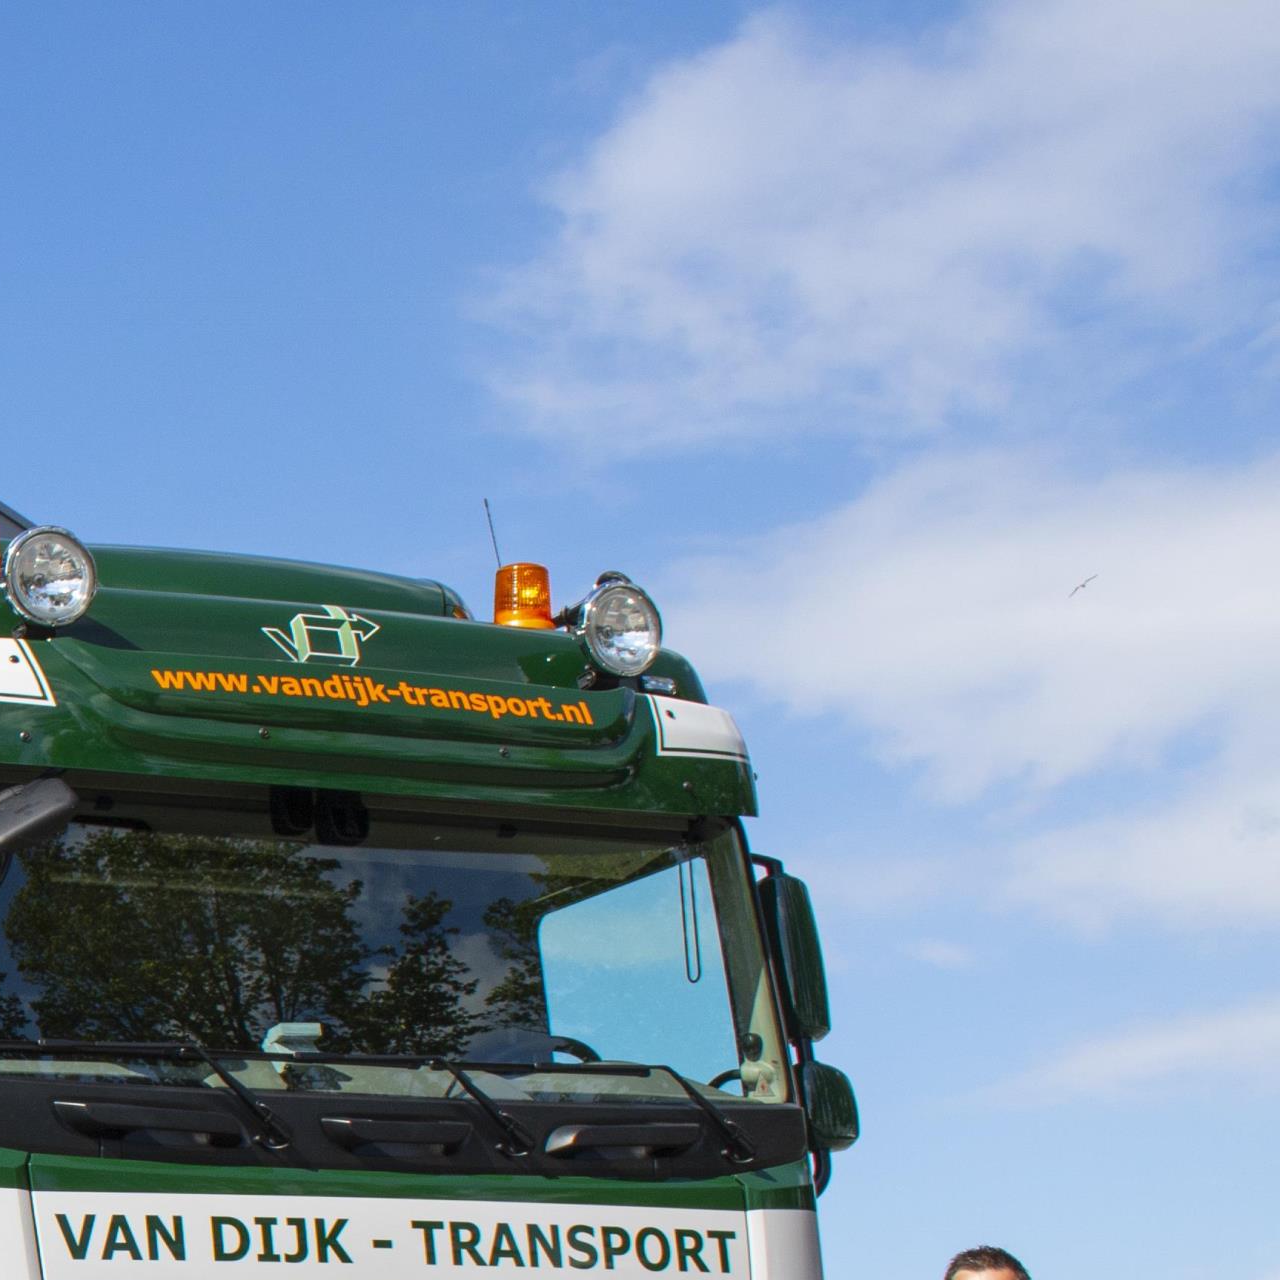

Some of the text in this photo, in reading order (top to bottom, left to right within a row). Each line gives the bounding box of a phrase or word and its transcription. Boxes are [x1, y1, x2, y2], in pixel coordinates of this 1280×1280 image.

[150, 669, 594, 726] www.vandijk-transport.nl
[55, 1213, 186, 1261] VAN
[211, 1216, 353, 1264] DIJK
[411, 1220, 736, 1274] TRANSPORT
